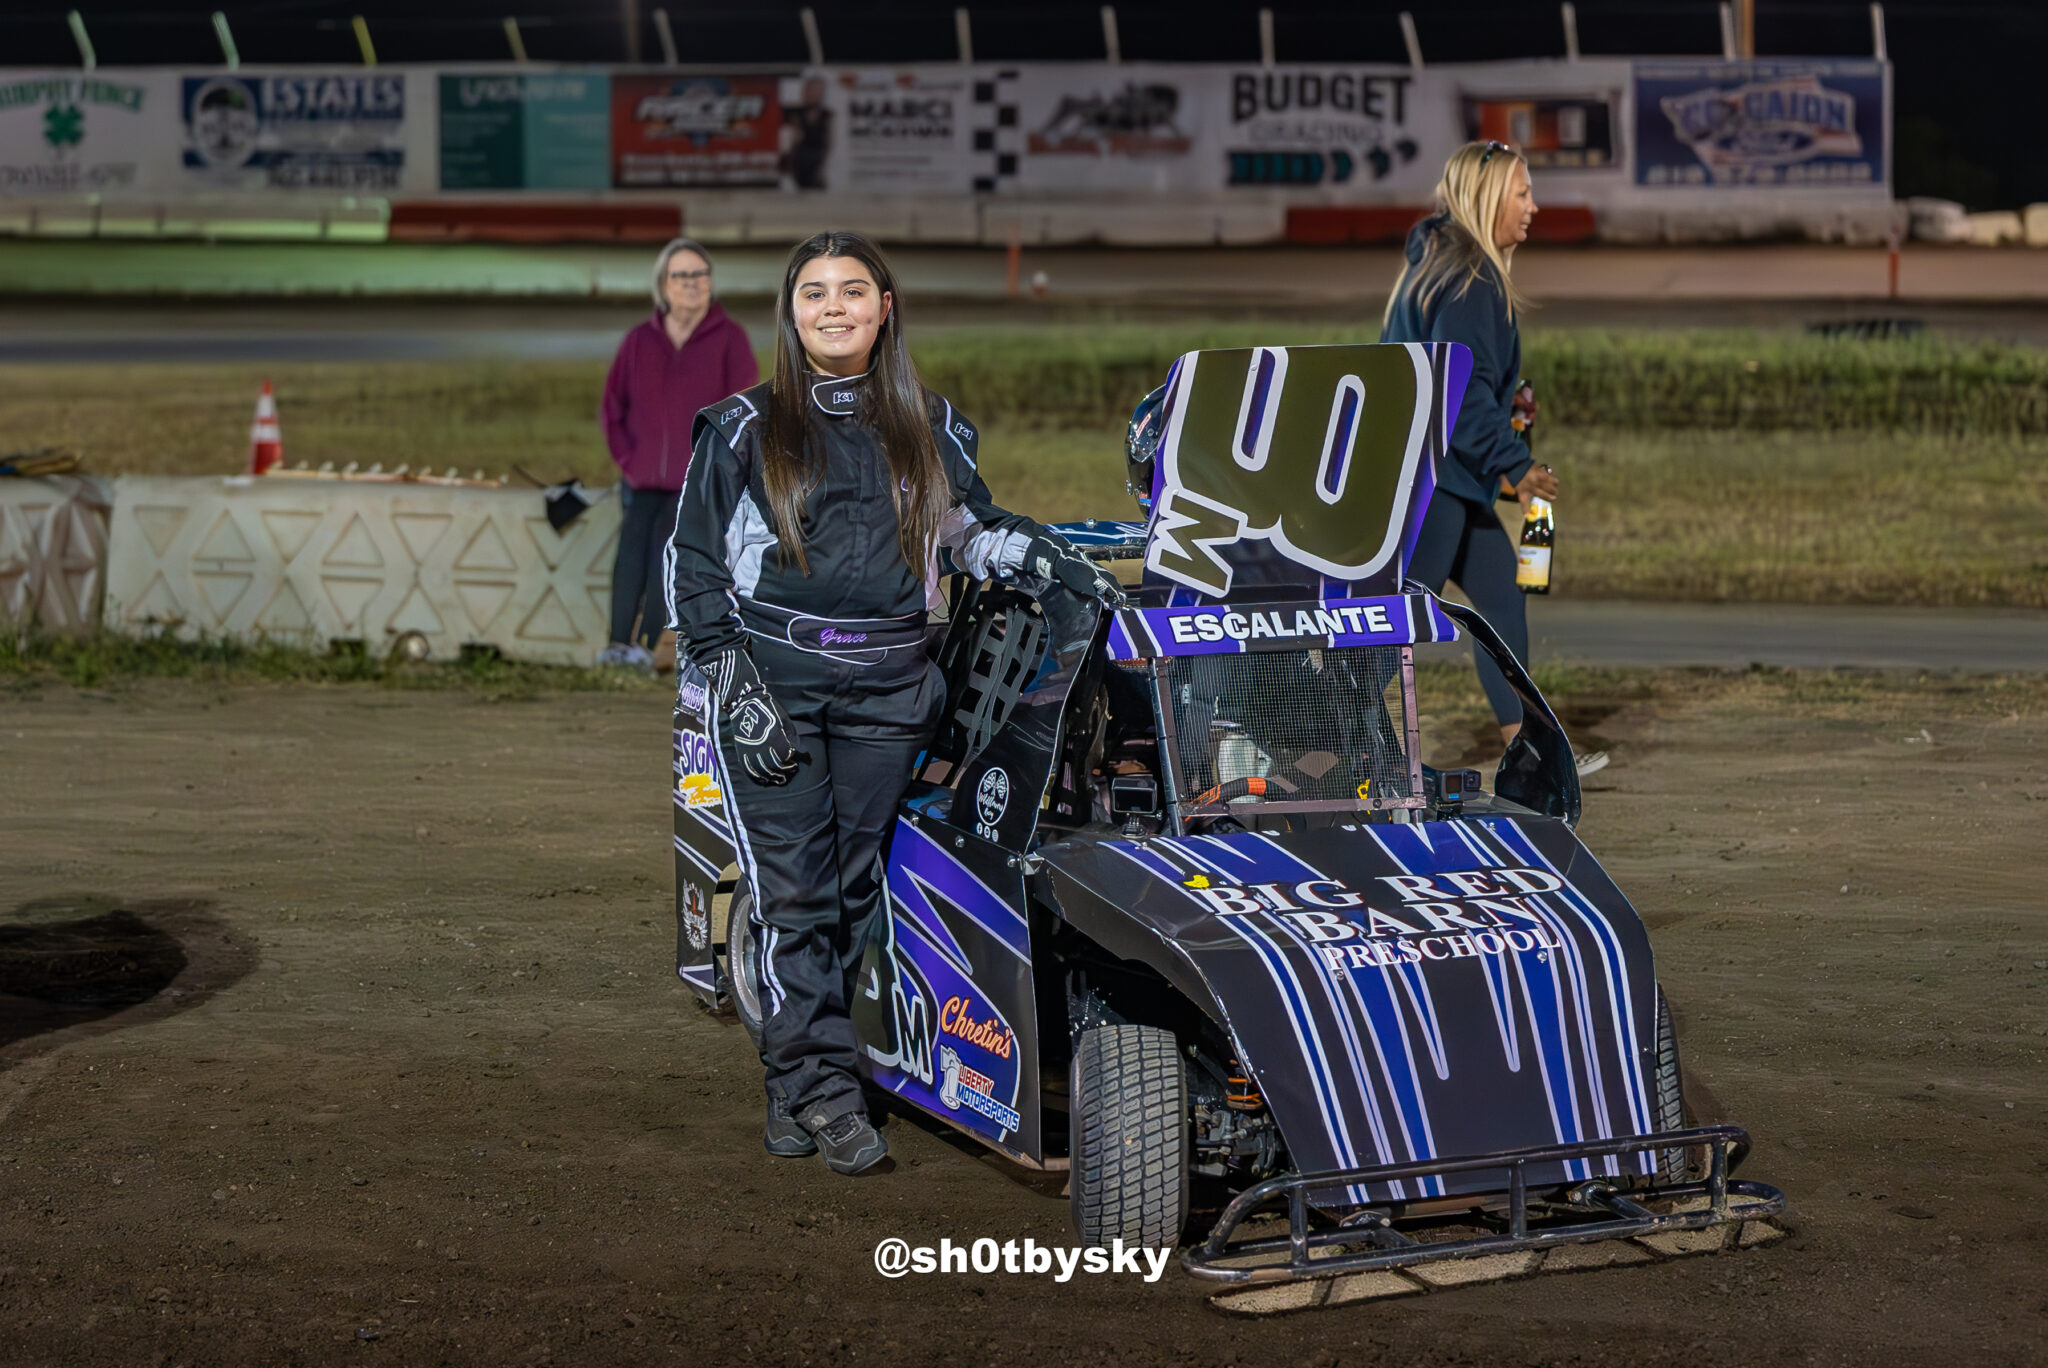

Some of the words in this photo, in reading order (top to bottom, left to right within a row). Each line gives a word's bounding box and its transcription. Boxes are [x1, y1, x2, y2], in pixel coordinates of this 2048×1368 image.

[1233, 74, 1413, 124] BUDGET
[820, 627, 868, 647] Grace
[1168, 605, 1395, 644] ESCALANTE
[1189, 880, 1364, 916] BIG
[1374, 869, 1563, 902] RED
[1281, 897, 1543, 943] BARN
[1321, 928, 1562, 971] PRESCHOOL
[940, 994, 1012, 1060] Chretin's
[958, 1064, 994, 1097] LIBERTY
[956, 1082, 1021, 1133] MOTORSPORTS
